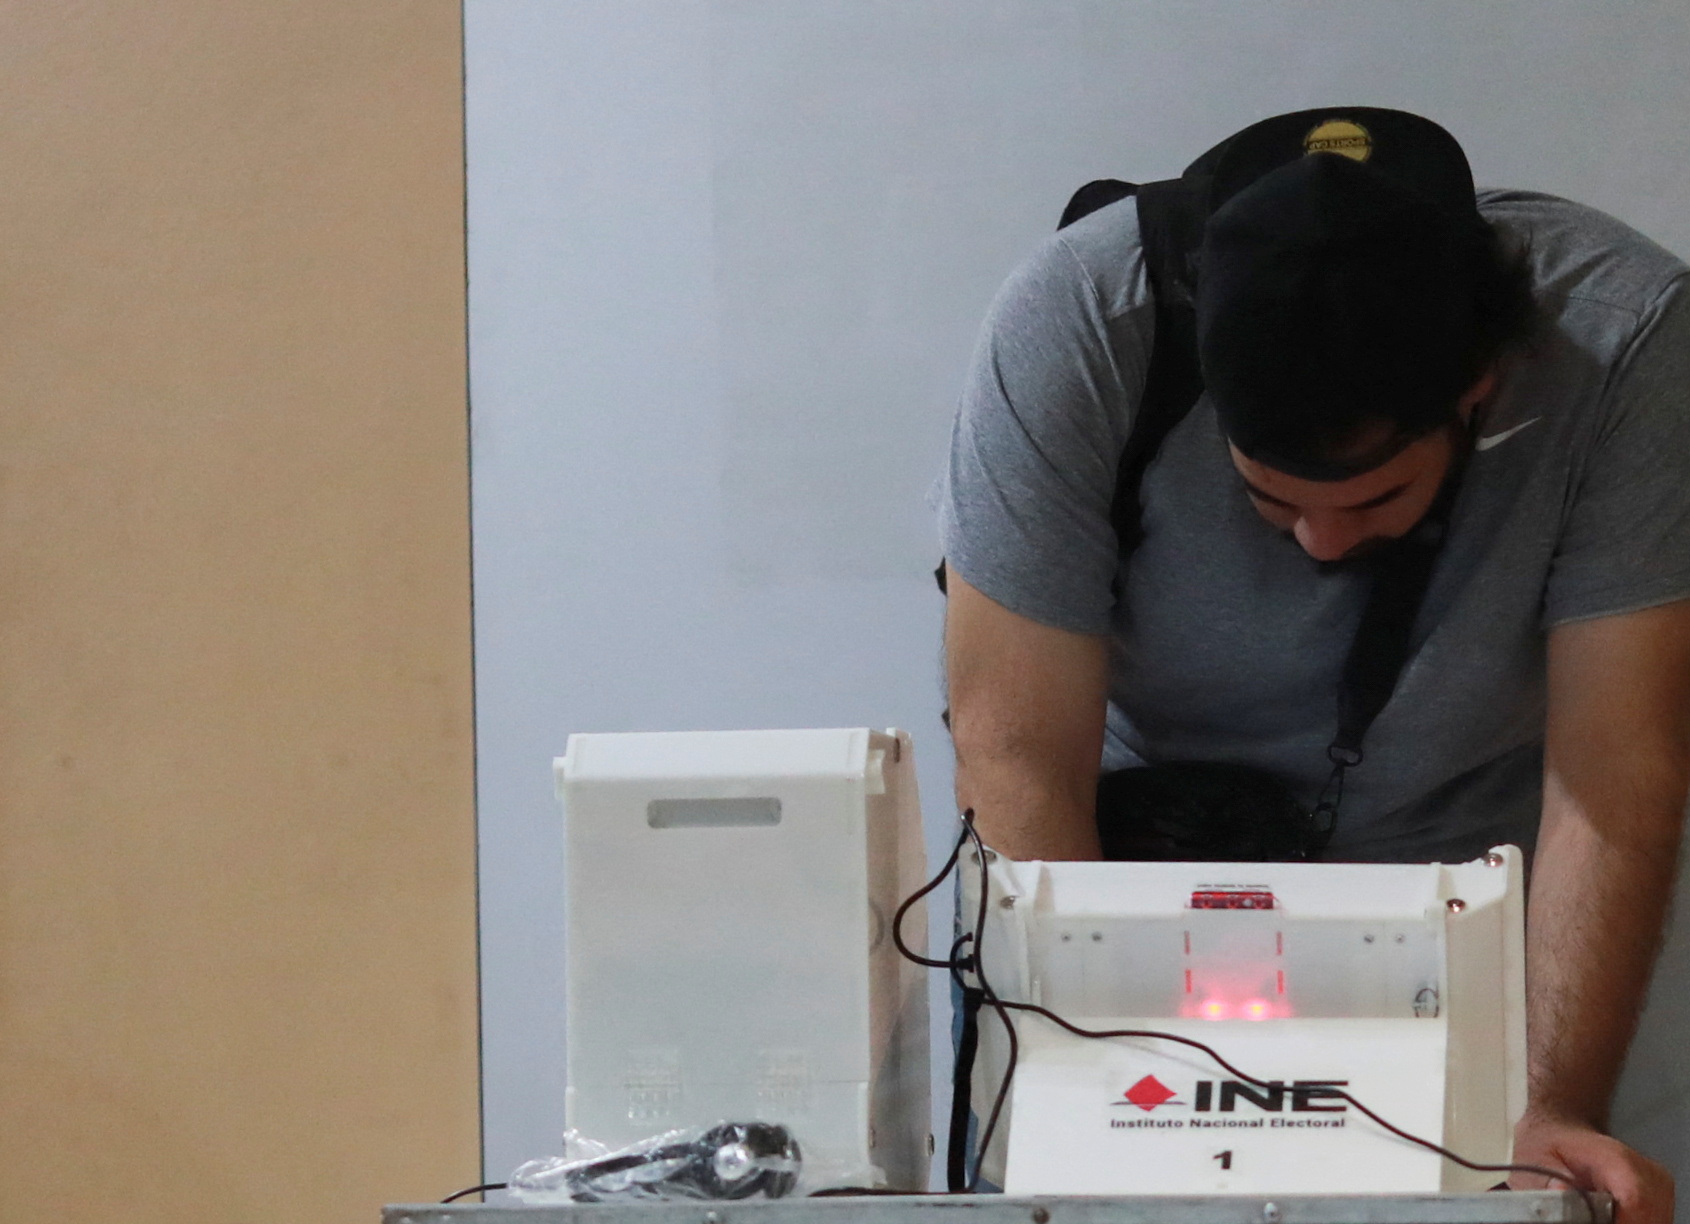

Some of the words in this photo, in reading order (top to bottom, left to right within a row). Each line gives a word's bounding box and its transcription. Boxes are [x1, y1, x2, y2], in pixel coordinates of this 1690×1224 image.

[1308, 140, 1328, 150] CAP
[1195, 1080, 1349, 1112] INE
[1110, 1118, 1184, 1128] Instituto
[1190, 1118, 1264, 1128] Nacional
[1270, 1118, 1346, 1128] Electoral
[1213, 1150, 1233, 1170] 1
